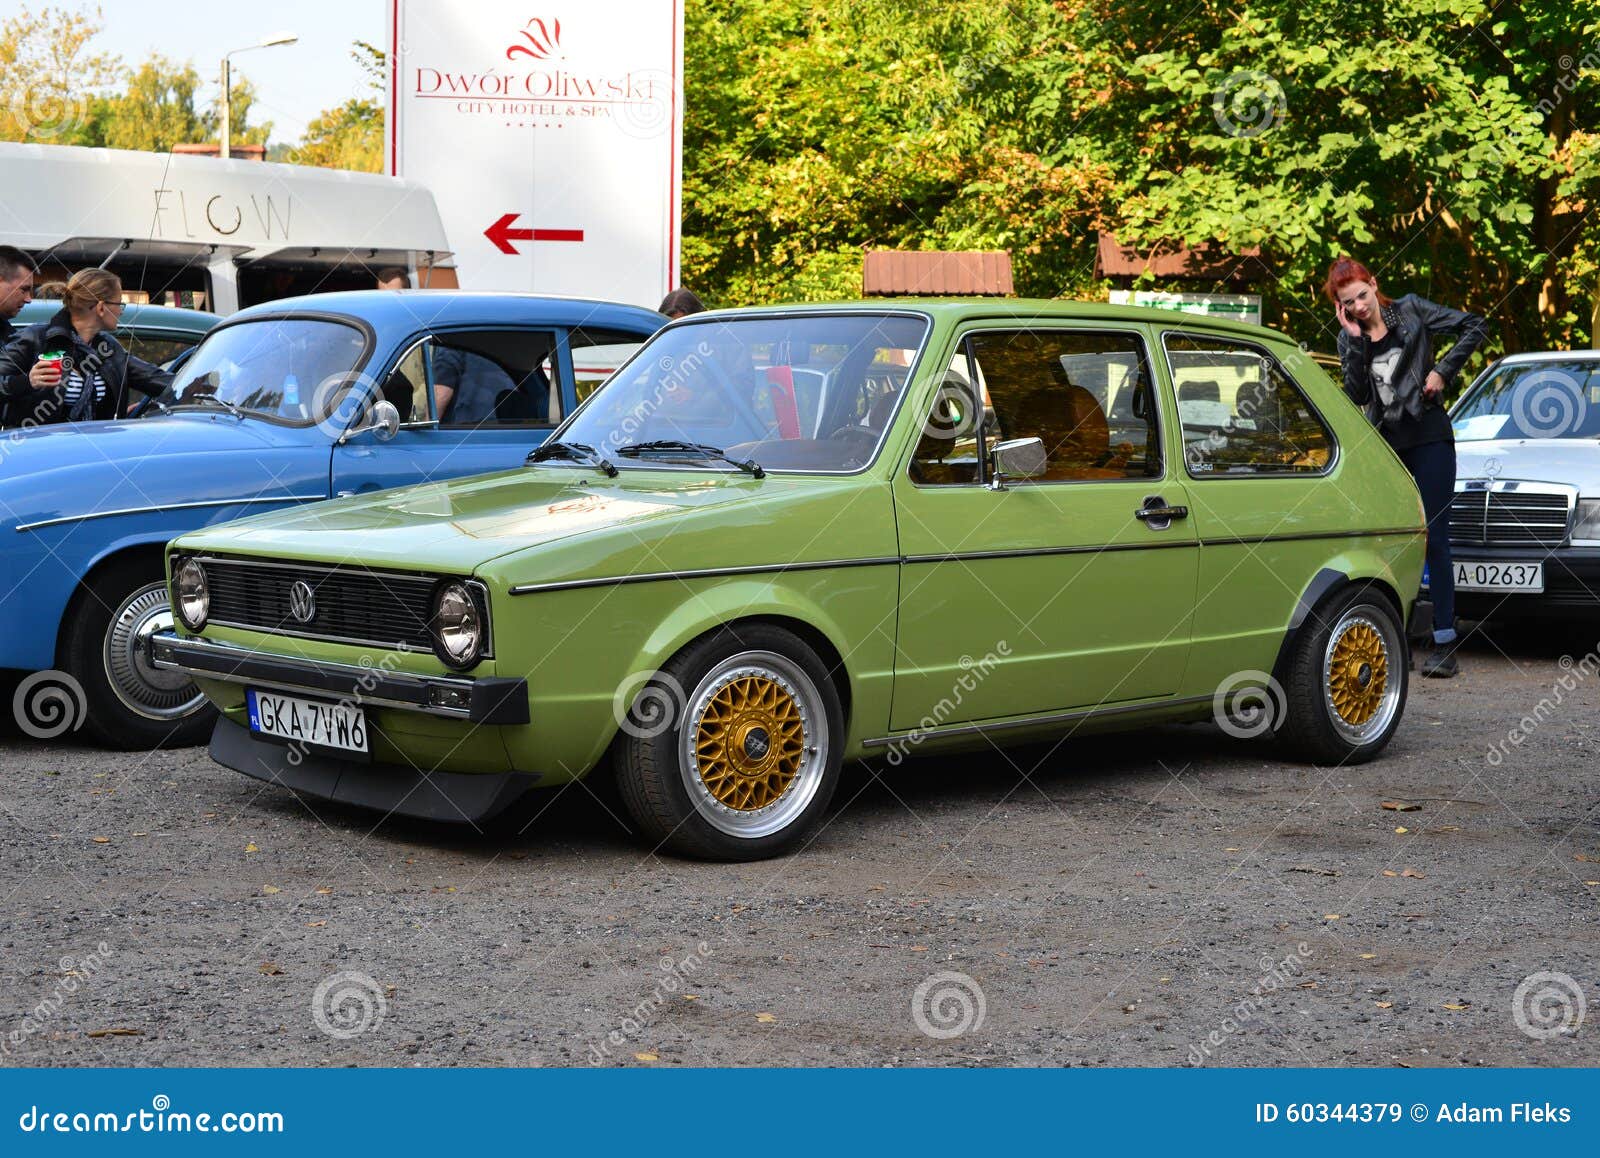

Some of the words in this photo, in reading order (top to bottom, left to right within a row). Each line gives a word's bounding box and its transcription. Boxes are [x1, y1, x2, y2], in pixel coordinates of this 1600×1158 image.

[416, 67, 514, 94] Dwór
[525, 70, 654, 98] Oliwski
[457, 101, 497, 114] CITY
[502, 103, 561, 116] HOTEL
[565, 105, 576, 117] &
[581, 105, 611, 117] SPA
[155, 189, 292, 240] FLOW
[1475, 564, 1539, 586] 02637
[259, 696, 304, 738] GKA
[306, 704, 364, 749] 7VW6
